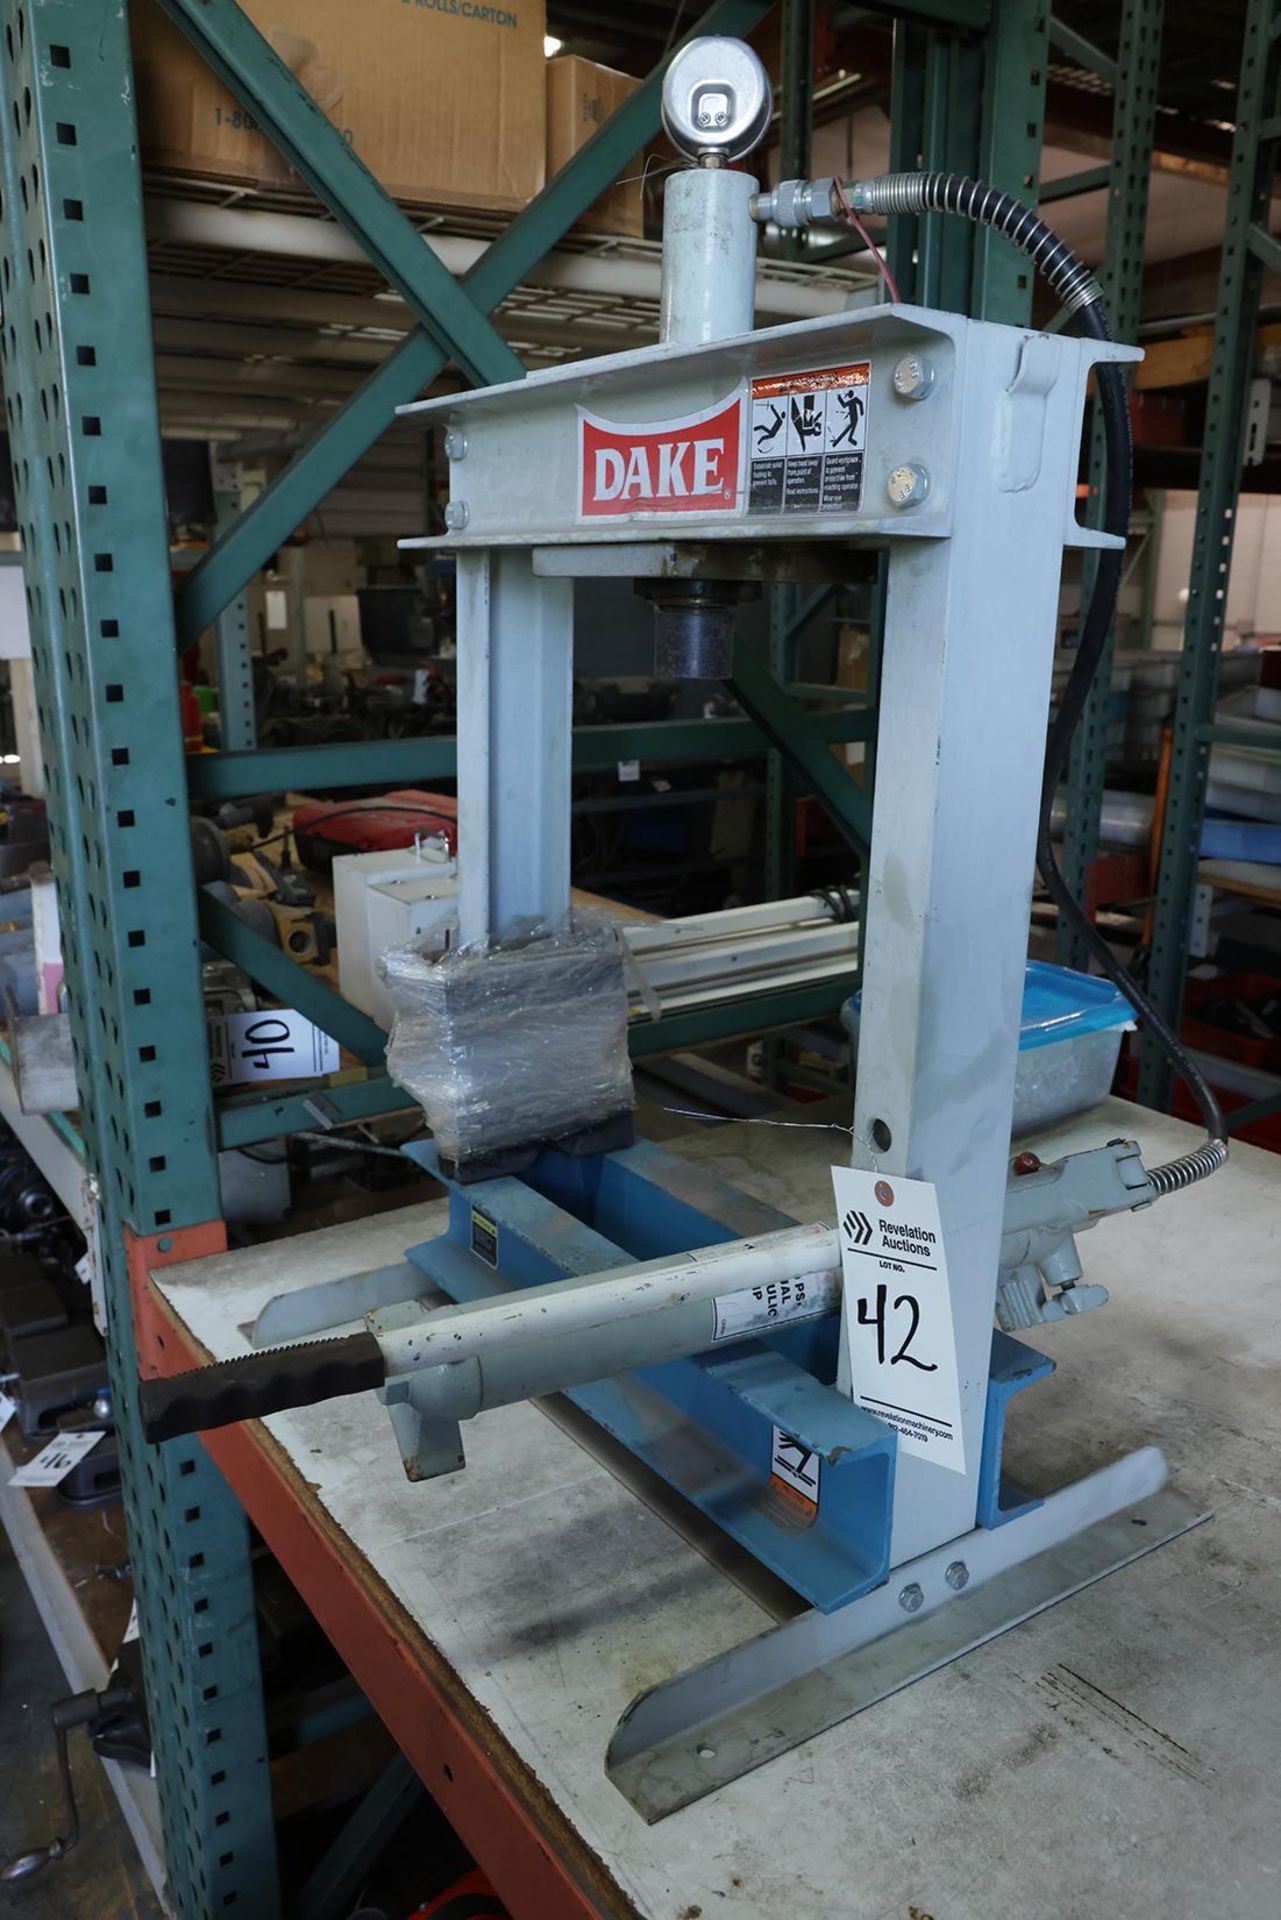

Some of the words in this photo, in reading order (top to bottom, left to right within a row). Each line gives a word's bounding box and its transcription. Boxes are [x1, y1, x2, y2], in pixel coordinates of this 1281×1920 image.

[593, 438, 724, 501] DAKE
[241, 1019, 295, 1069] 40
[879, 1218, 937, 1244] Revelation
[882, 1235, 931, 1257] Auctions
[879, 1260, 892, 1269] LOT
[857, 1284, 938, 1372] 42
